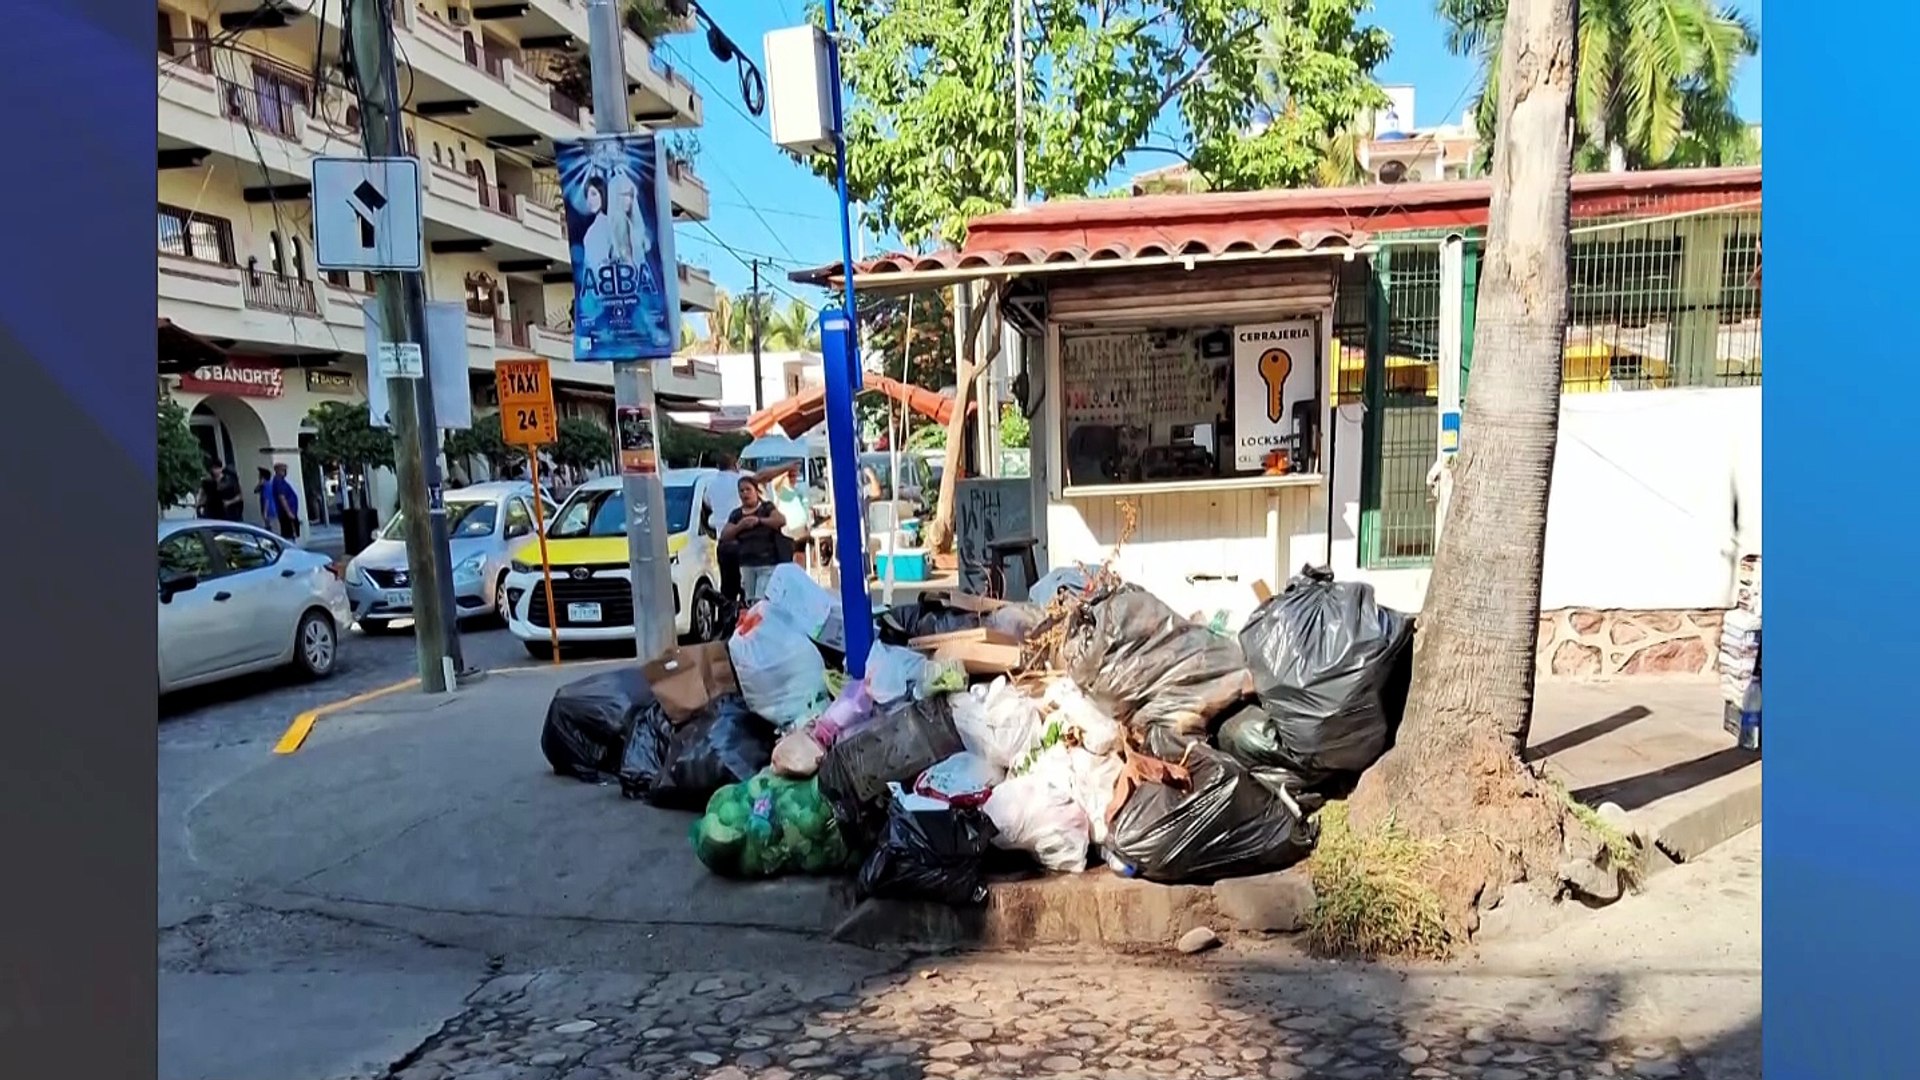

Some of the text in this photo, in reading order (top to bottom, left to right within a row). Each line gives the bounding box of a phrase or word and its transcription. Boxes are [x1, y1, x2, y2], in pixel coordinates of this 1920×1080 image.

[581, 262, 659, 298] ABBA
[1239, 328, 1310, 343] CERRAJERIA
[212, 366, 282, 386] BANORTE
[508, 373, 540, 394] TAXI
[517, 408, 539, 430] 24
[1241, 434, 1294, 447] LOCKSM
